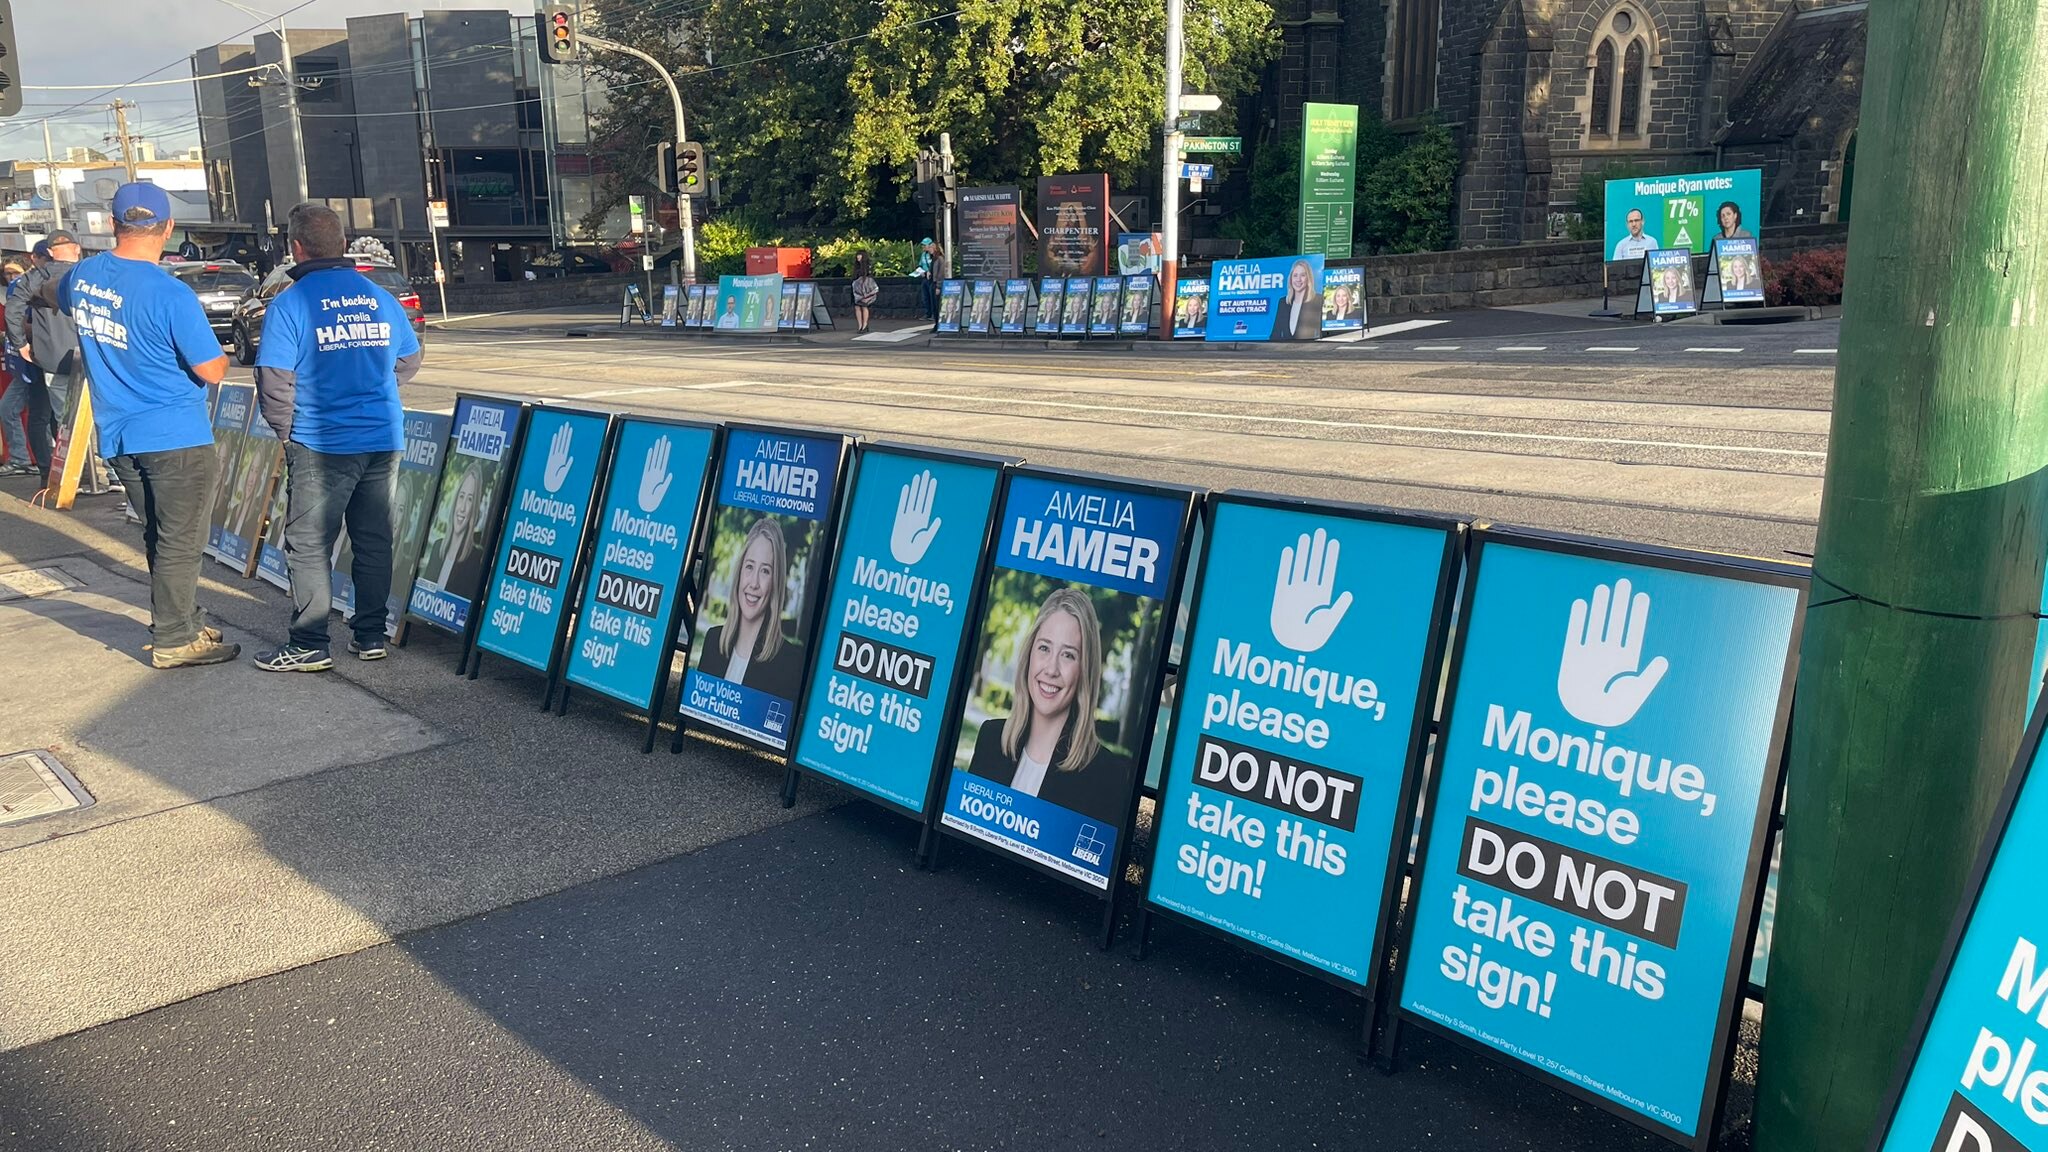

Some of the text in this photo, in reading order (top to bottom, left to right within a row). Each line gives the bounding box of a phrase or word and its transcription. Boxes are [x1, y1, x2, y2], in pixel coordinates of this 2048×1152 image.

[1183, 142, 1240, 150] PAKINGTON ST
[1634, 177, 1733, 196] Monique Ryan votes:
[1668, 199, 1698, 218] 77%
[1044, 227, 1098, 235] CHARPENTIER
[1652, 256, 1688, 266] HAMER
[1722, 244, 1752, 252] HAMER
[1218, 274, 1284, 290] HAMER
[1220, 264, 1260, 275] AMELIA
[1326, 274, 1360, 283] HAMER
[74, 279, 123, 309] I'm backing
[321, 294, 378, 310] I'm backing
[316, 322, 390, 344] HAMER
[337, 312, 371, 323] Amelia
[319, 342, 347, 351] LIBERAL
[220, 402, 246, 421] HAMER
[471, 406, 501, 429] AMELIA
[405, 420, 432, 439] AMELIA
[460, 429, 503, 456] HAMER
[755, 440, 806, 464] AMELIA
[736, 460, 819, 498] HAMER
[520, 489, 577, 526] Monique,
[733, 490, 814, 512] LIBERAL FOR KOOYONG
[1044, 490, 1134, 531] AMELIA
[512, 518, 556, 547] please
[612, 508, 678, 550] Monique,
[603, 540, 655, 571] please
[1010, 517, 1160, 583] HAMER
[508, 549, 560, 583] DO NOT
[499, 579, 553, 615] take this
[598, 574, 659, 612] DO NOT
[852, 556, 954, 615] Monique,
[410, 589, 456, 622] KOOYONG
[491, 605, 523, 635] sign!
[843, 594, 919, 638] please
[590, 606, 651, 647] take this
[582, 636, 618, 668] sign!
[839, 637, 930, 690] DO NOT
[694, 674, 742, 705] Your Voice.
[1212, 638, 1386, 721] Monique,
[691, 690, 740, 720] Our Future.
[827, 675, 921, 734] take this
[1203, 690, 1329, 749] please
[764, 720, 783, 733] LIBERAL
[818, 713, 873, 754] sign!
[1482, 704, 1717, 816] Monique,
[964, 780, 1013, 807] LIBERAL FOR
[1200, 742, 1354, 820] DO NOT
[960, 793, 1040, 840] KOOYONG
[1470, 767, 1640, 845] please
[1187, 792, 1346, 876] take this
[1072, 846, 1100, 866] LIBERAL
[1177, 842, 1266, 899] sign!
[1468, 828, 1675, 933] DO NOT
[1452, 884, 1666, 1000] take this
[1441, 945, 1558, 1018] sign!
[1412, 1001, 1444, 1020] Authorised
[1458, 1020, 1477, 1035] Smith,
[1478, 1030, 1500, 1044] Liberal
[1500, 1038, 1518, 1053] Party,
[1519, 1047, 1536, 1060] Level
[1560, 1064, 1581, 1080] Collins
[1582, 1074, 1605, 1092] Street,
[1606, 1085, 1645, 1108] Melbourne
[1660, 1108, 1682, 1124] 3000
